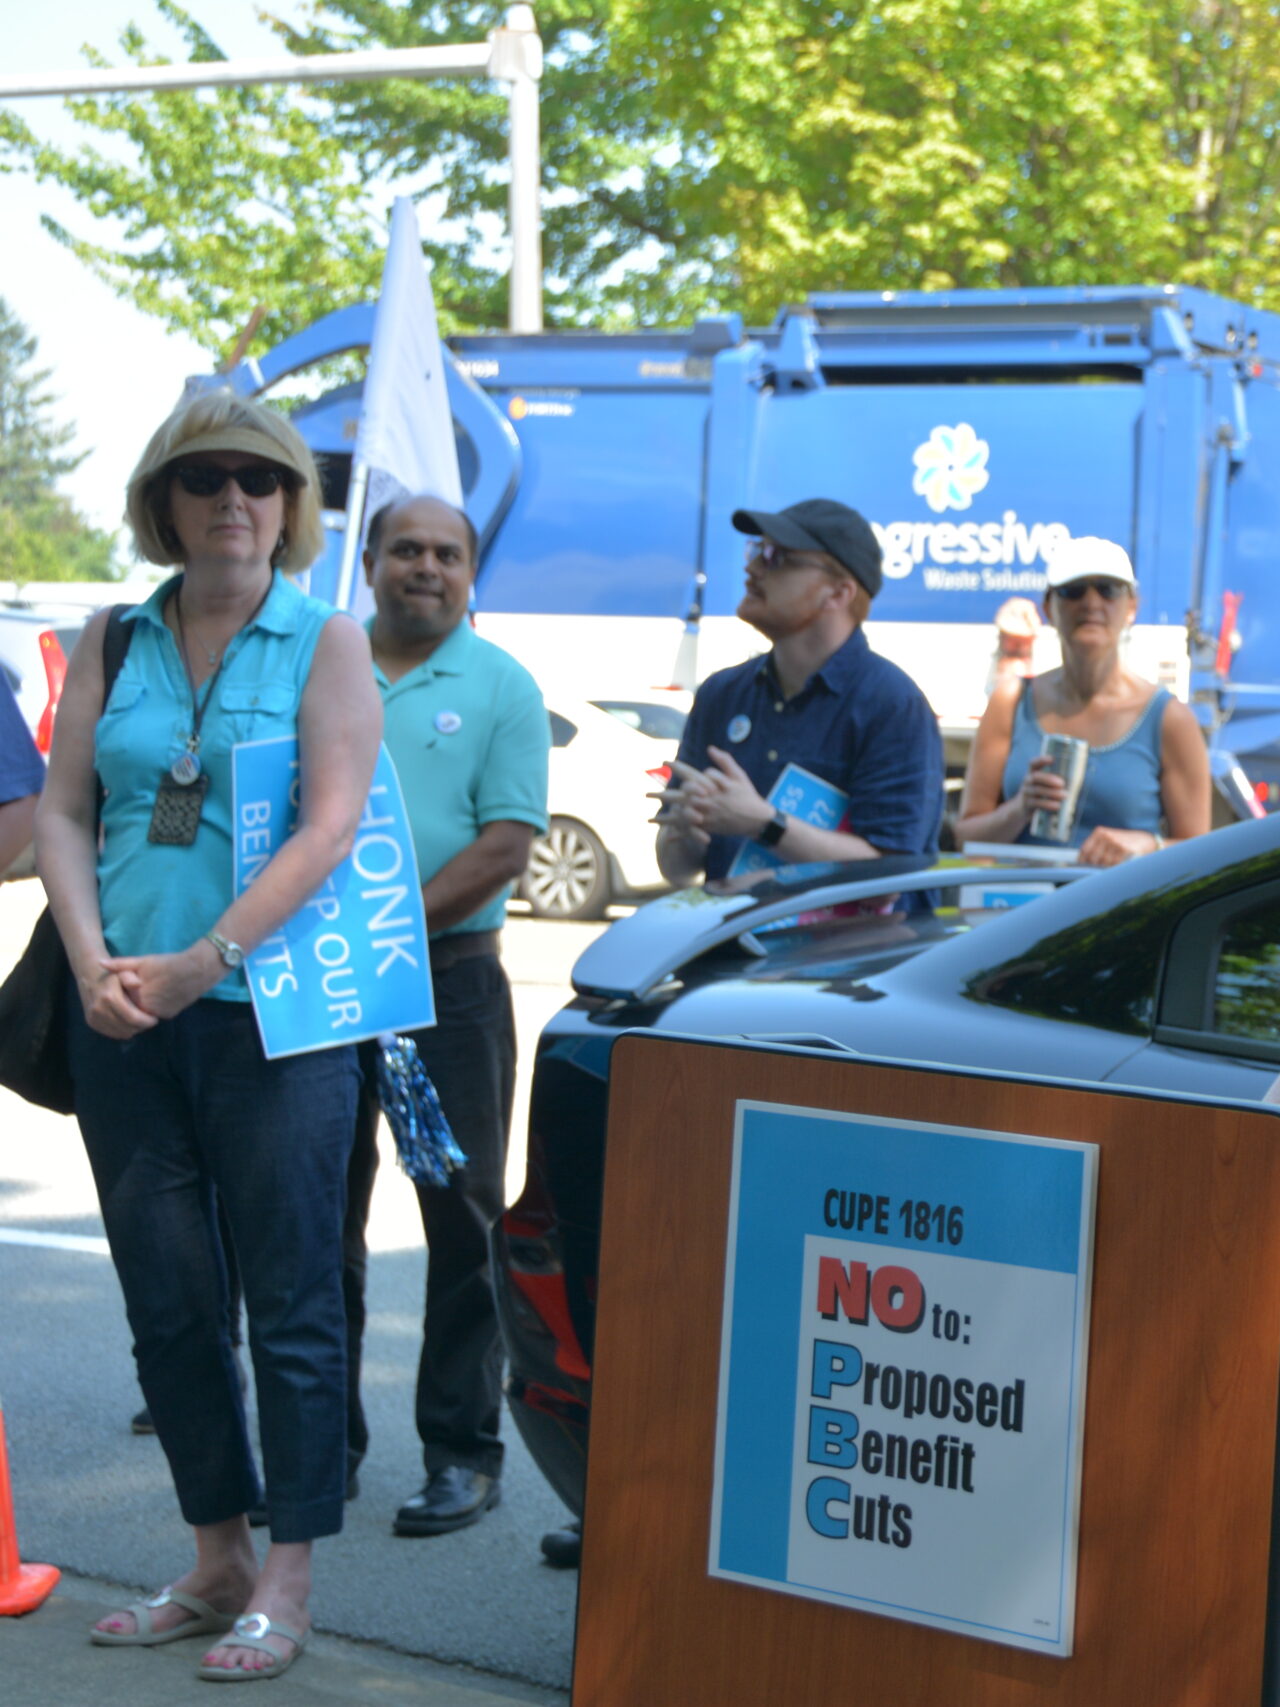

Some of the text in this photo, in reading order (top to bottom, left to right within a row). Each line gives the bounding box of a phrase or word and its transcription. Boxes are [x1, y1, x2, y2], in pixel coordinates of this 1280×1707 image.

[869, 510, 1072, 579] gressive
[923, 567, 1048, 591] Waste Solutio
[241, 799, 299, 999] BENITS
[352, 784, 419, 978] HONK
[314, 932, 362, 1030] OUR
[823, 1188, 964, 1246] CUPE 1816
[816, 1255, 971, 1345] NO to:
[811, 1338, 1026, 1433] Proposed
[807, 1404, 976, 1493] Benefit
[805, 1475, 913, 1549] Cuts
